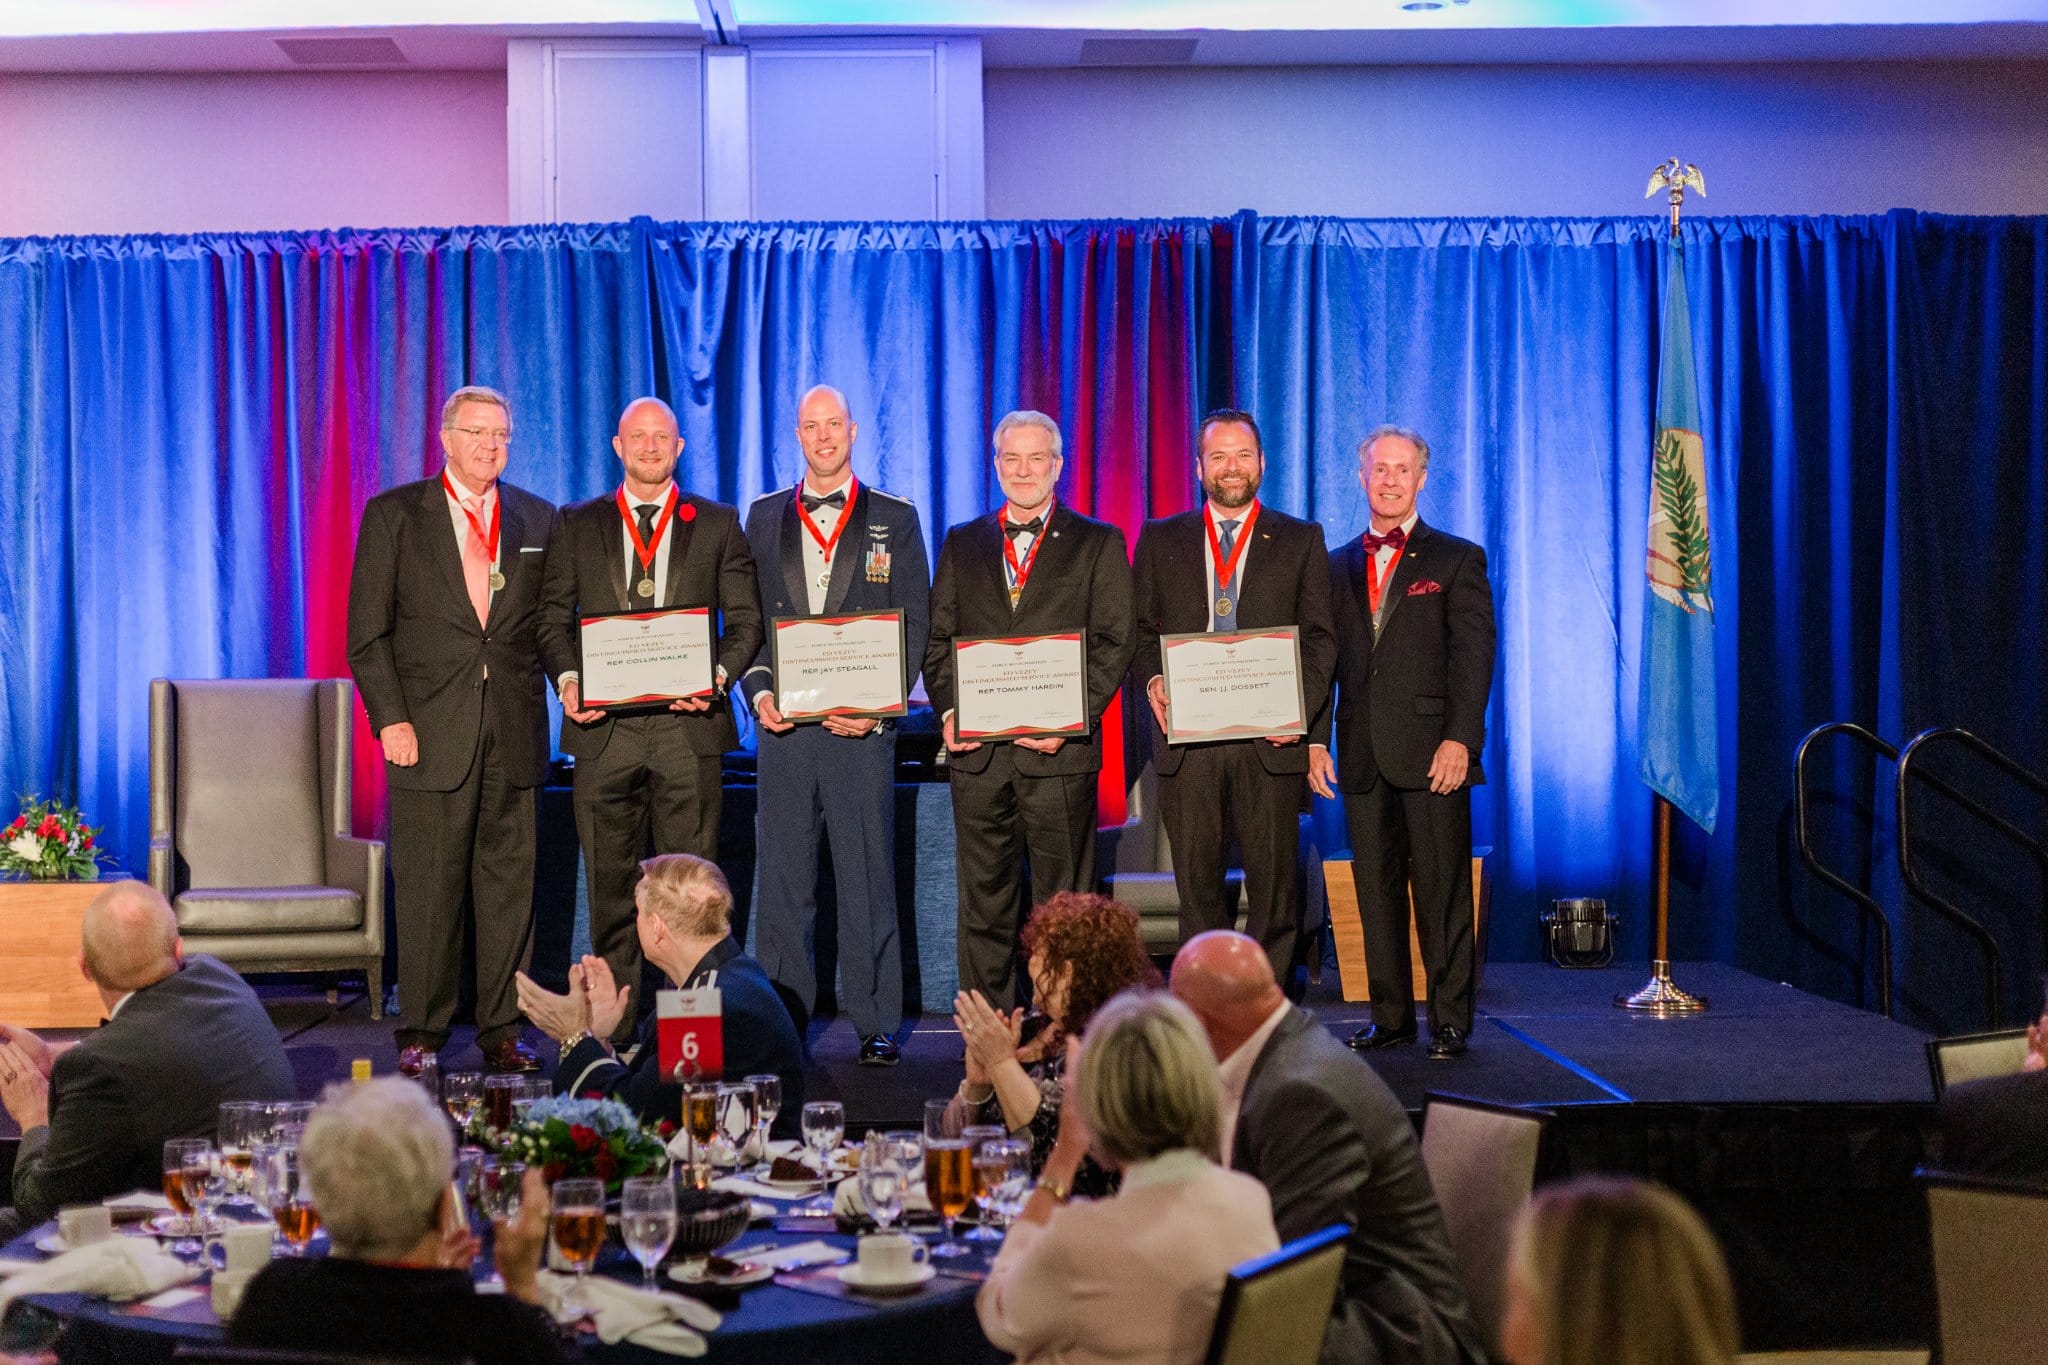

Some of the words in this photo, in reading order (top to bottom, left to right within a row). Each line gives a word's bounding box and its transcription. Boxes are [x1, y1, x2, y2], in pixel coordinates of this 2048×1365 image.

[836, 665, 879, 673] STEAGALL
[1231, 682, 1270, 690] DOSSETT
[682, 1031, 699, 1060] 6
